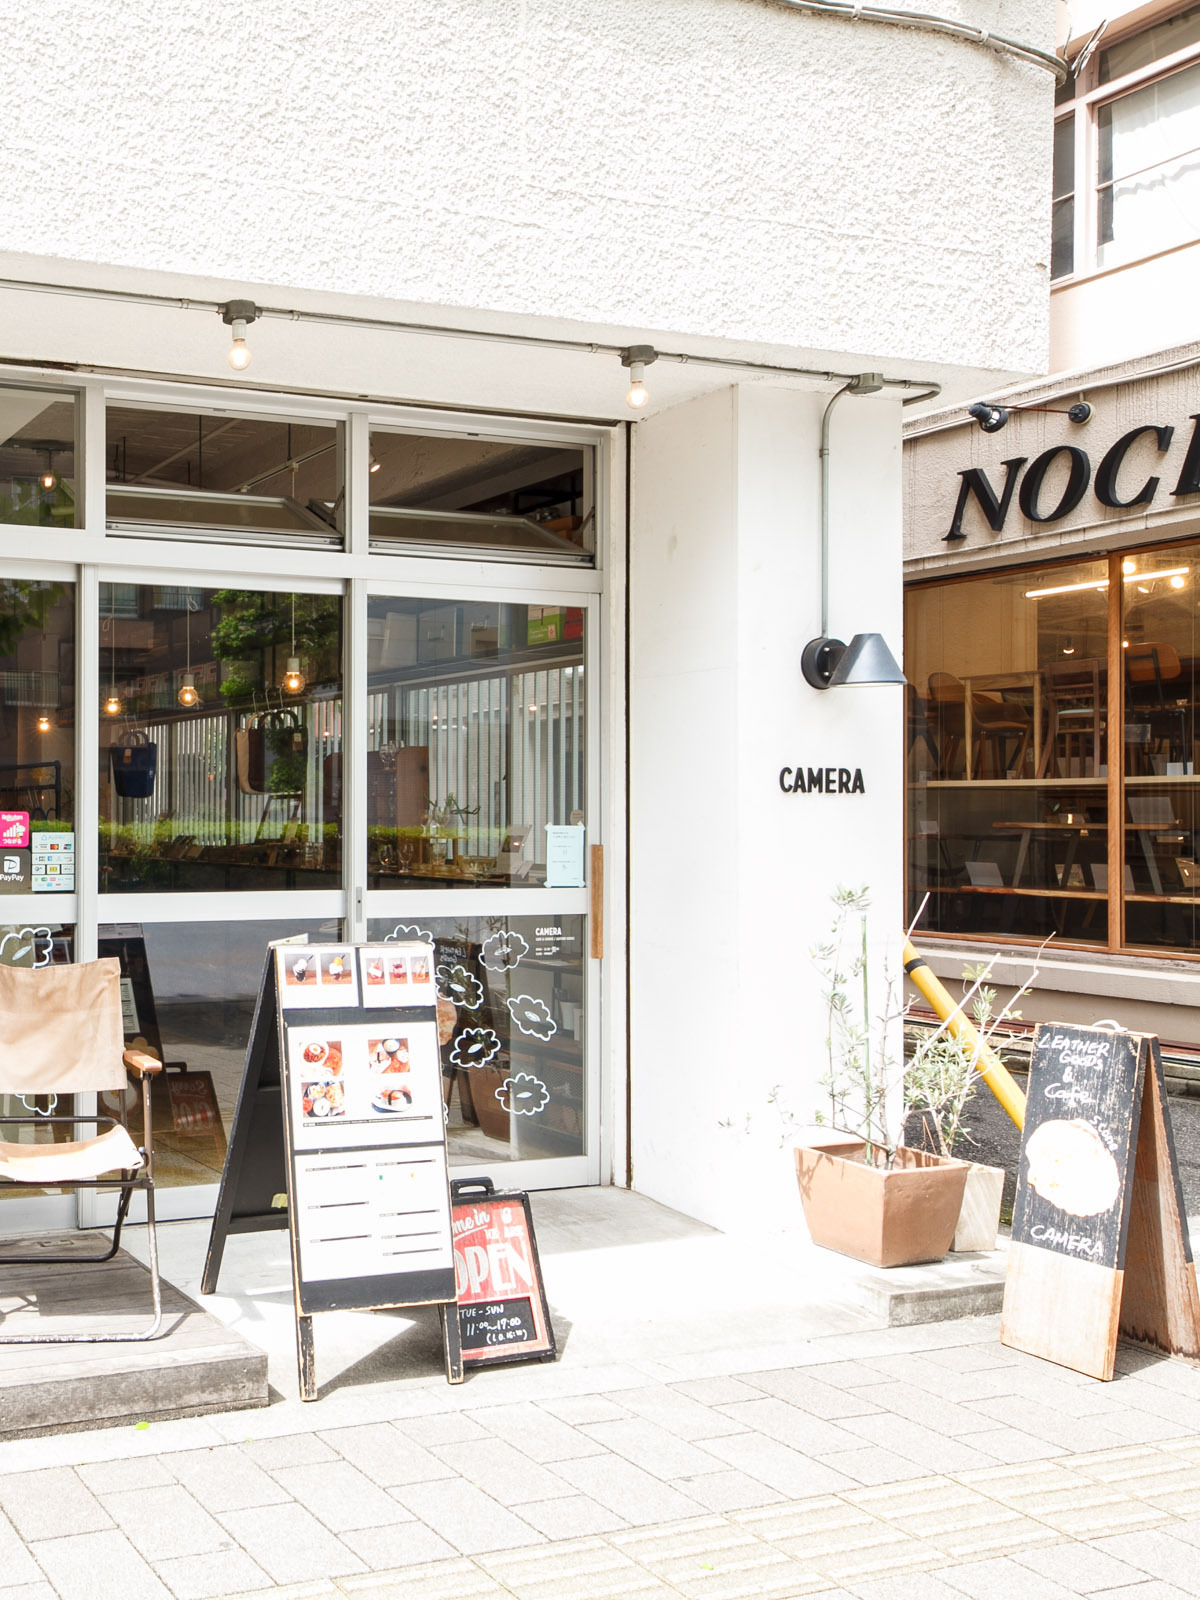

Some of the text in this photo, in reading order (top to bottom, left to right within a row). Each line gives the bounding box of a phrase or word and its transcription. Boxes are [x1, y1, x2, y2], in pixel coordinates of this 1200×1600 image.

[779, 767, 865, 793] CAMERA
[0, 874, 24, 882] PayPay
[535, 927, 562, 936] CAMERA
[1038, 1033, 1110, 1057] LEATHER
[452, 1208, 490, 1233] me in
[1030, 1225, 1104, 1257] CAMERA
[460, 1308, 476, 1319] TUE
[485, 1305, 504, 1316] SUN
